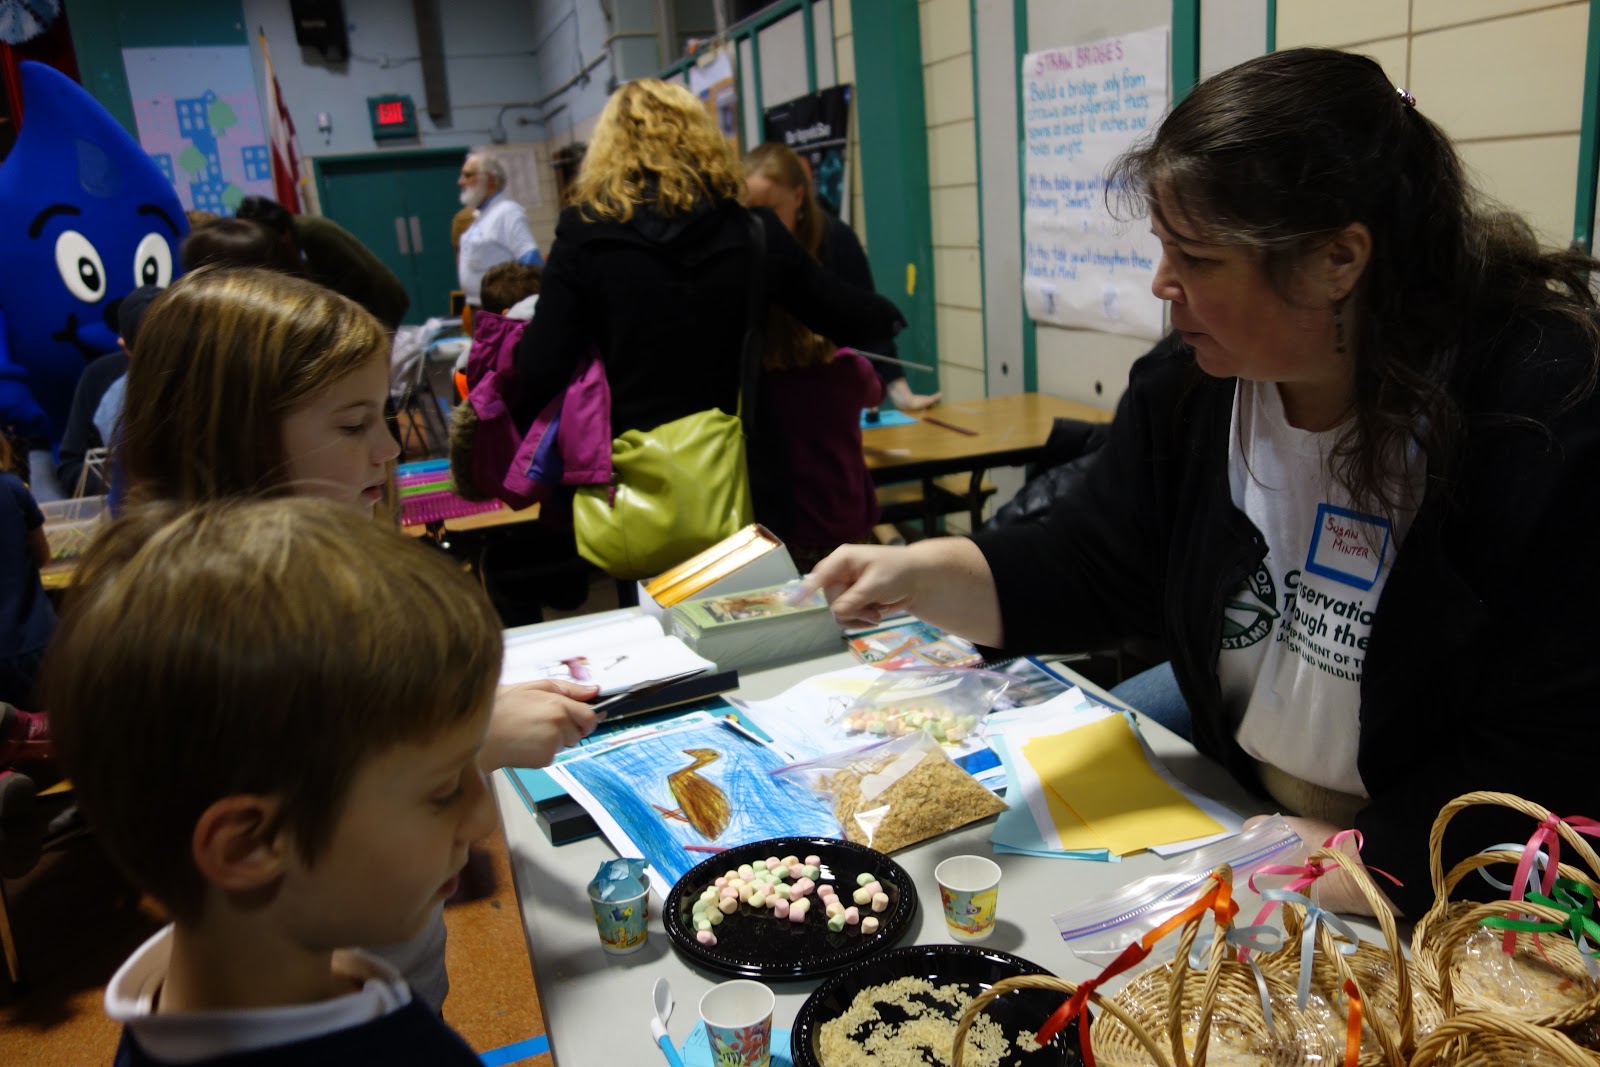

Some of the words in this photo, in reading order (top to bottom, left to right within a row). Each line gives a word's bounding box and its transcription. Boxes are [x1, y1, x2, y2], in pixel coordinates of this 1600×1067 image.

[1068, 79, 1098, 103] bridge
[1122, 66, 1146, 89] from
[378, 101, 403, 124] EXIT
[1325, 517, 1358, 539] SUSAN
[1332, 538, 1369, 558] MINTER
[1222, 620, 1270, 648] STAMP
[1334, 623, 1370, 651] the
[1334, 653, 1350, 666] OF
